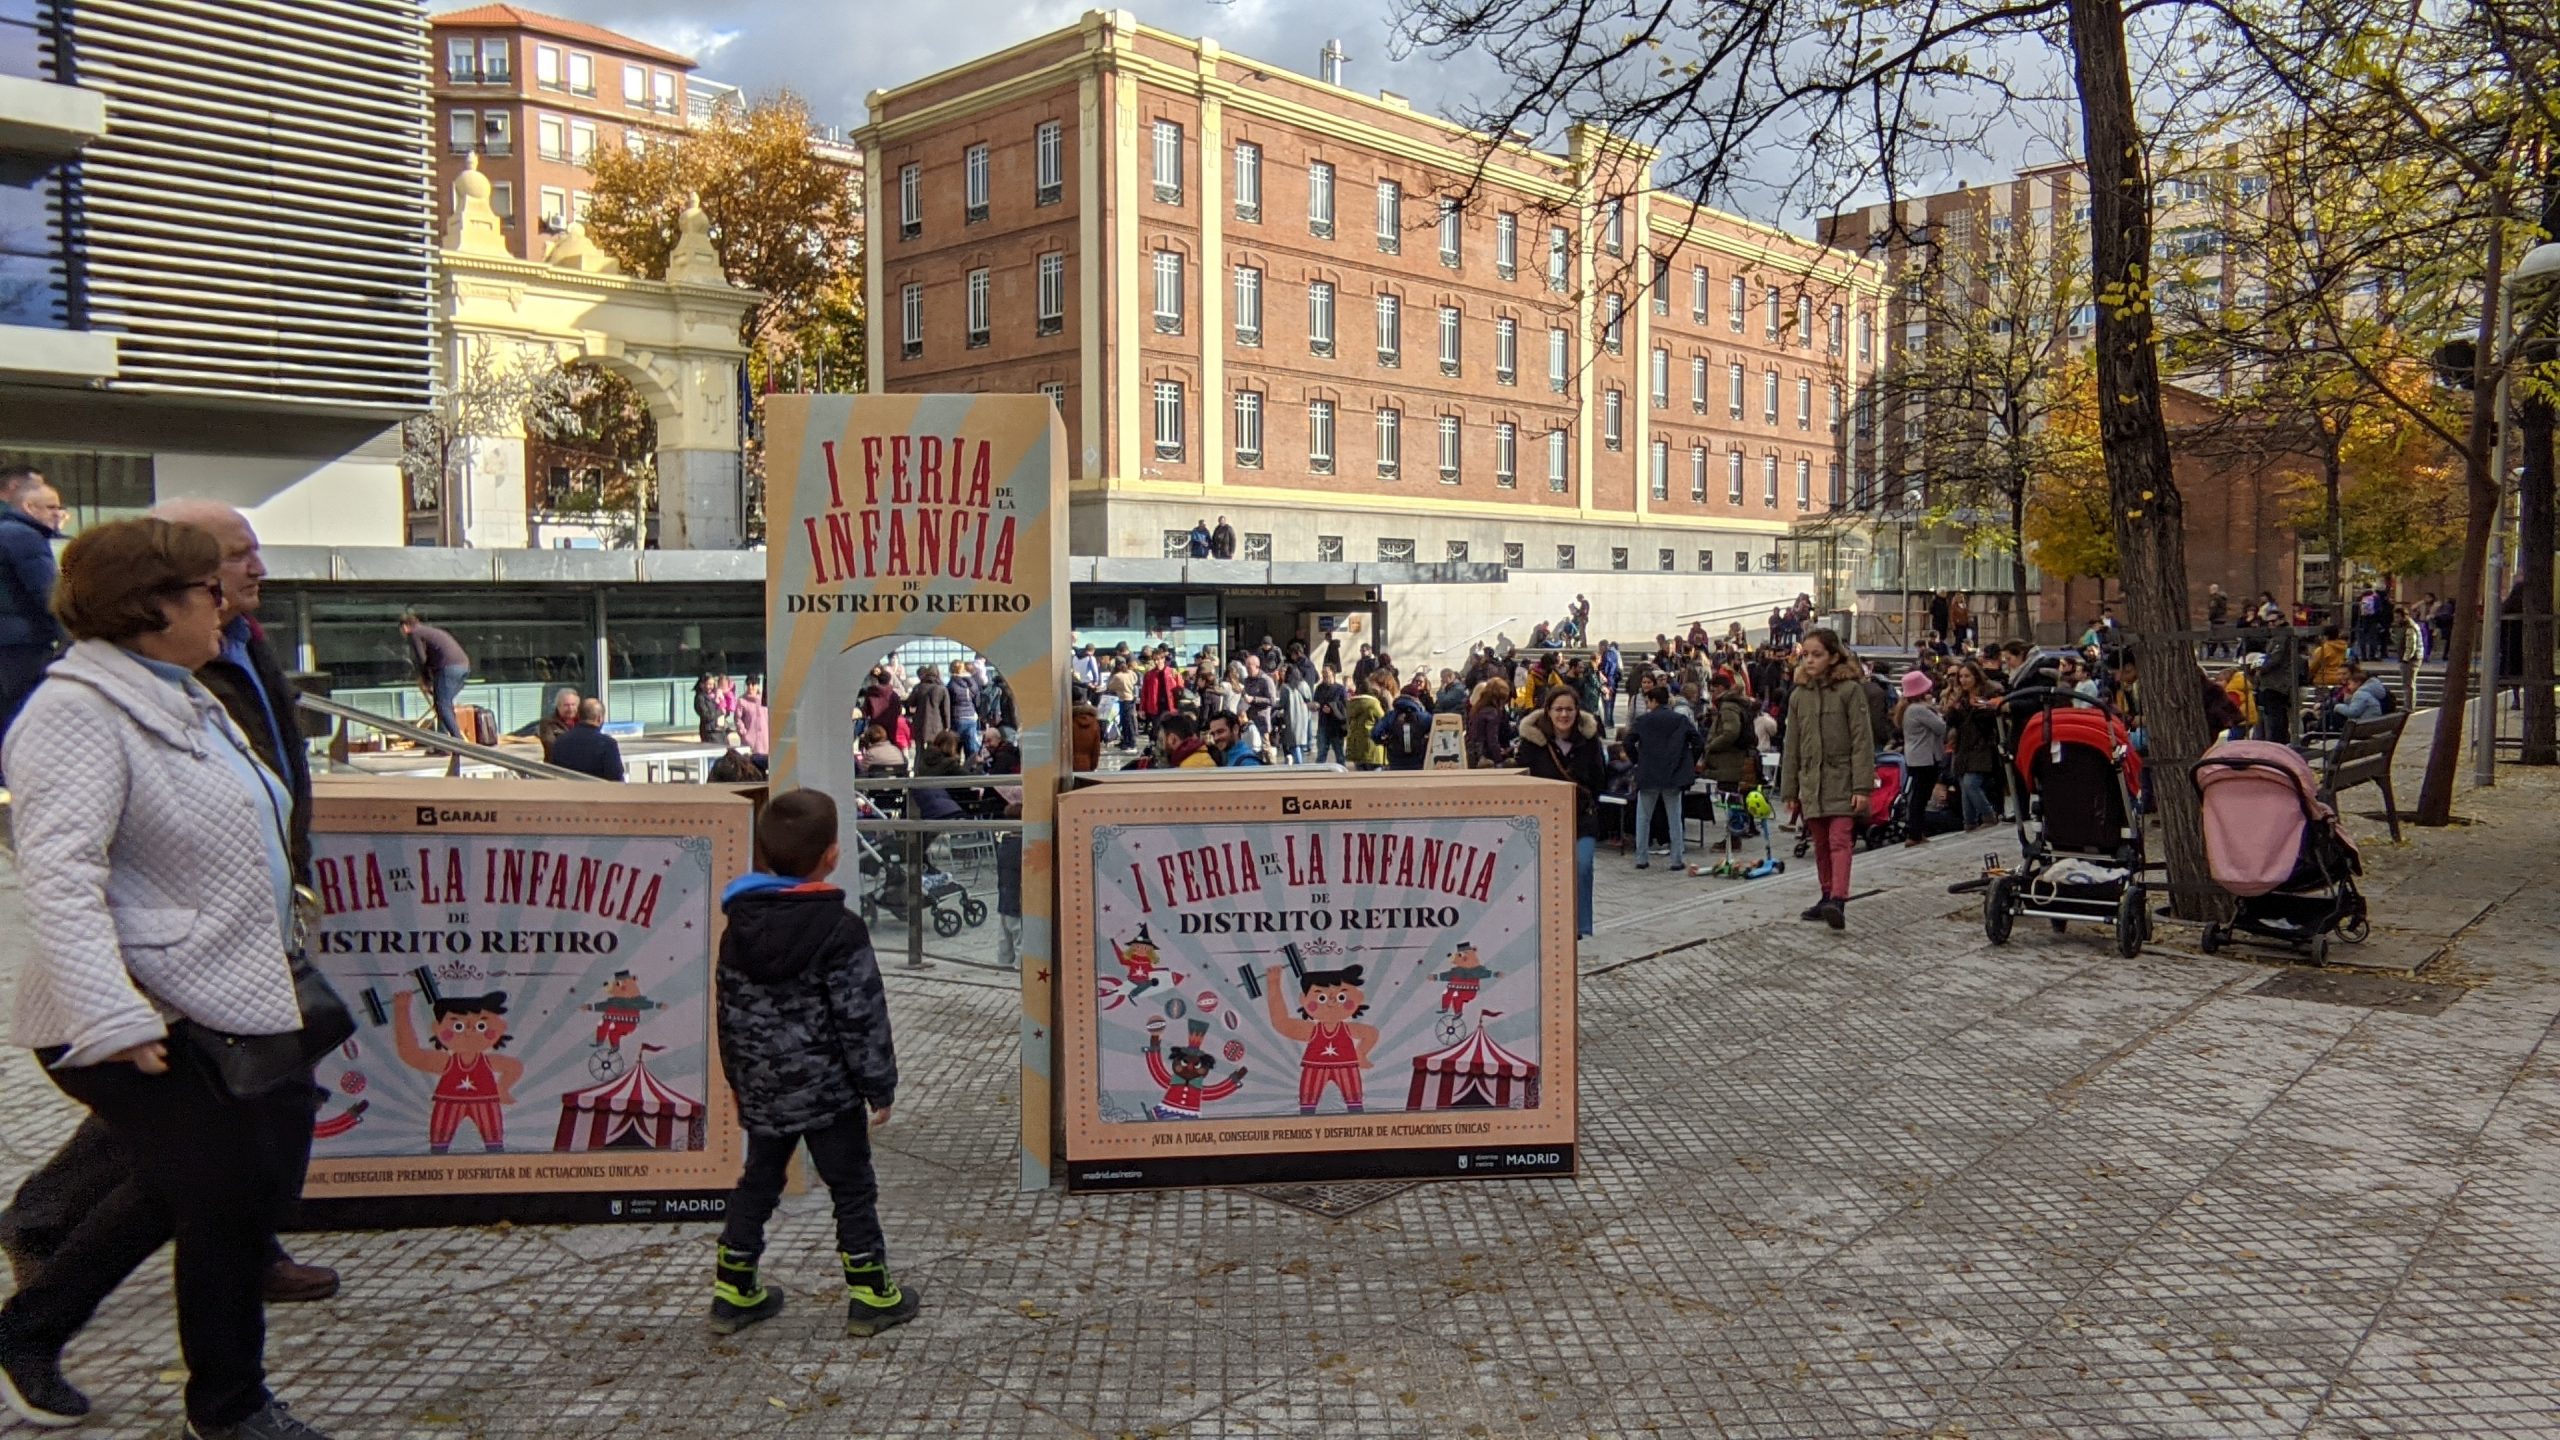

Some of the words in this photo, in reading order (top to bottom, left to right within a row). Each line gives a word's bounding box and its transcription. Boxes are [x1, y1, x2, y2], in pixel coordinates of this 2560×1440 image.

[822, 441, 843, 508] I
[862, 436, 991, 508] FERIA
[995, 487, 1014, 498] DE
[998, 500, 1016, 510] LA
[804, 508, 1016, 584] INFANCIA
[902, 581, 920, 592] DE
[787, 594, 919, 613] DISTRITO
[926, 593, 1031, 613] RETIRO
[1302, 799, 1352, 810] GARAJE
[440, 811, 497, 822] GARAJE
[1260, 853, 1279, 865] DE
[389, 867, 411, 880] DE
[1265, 865, 1283, 876] LA
[1284, 834, 1326, 886] LA
[1342, 833, 1496, 902] INFANCIA
[316, 850, 389, 915] RIA
[1130, 863, 1152, 913] I
[1157, 840, 1261, 907] FERIA
[393, 880, 415, 892] LA
[419, 848, 466, 904] LA
[484, 848, 662, 928] INFANCIA
[1311, 893, 1330, 904] DE
[448, 913, 470, 924] DE
[1179, 910, 1332, 934] DISTRITO
[1339, 906, 1460, 930] RETIRO
[319, 930, 472, 954] ISTRITO
[481, 930, 618, 954] RETIRO
[1176, 1133, 1183, 1144] A
[1185, 1132, 1217, 1146] JUGAR,
[1219, 1130, 1270, 1143] CONSEGUIR
[1272, 1128, 1313, 1140] PREMIOS
[1315, 1128, 1321, 1139] Y
[1324, 1126, 1373, 1139] DISFRUTAR
[1376, 1125, 1388, 1137] DE
[1391, 1123, 1452, 1136] ACTUACIONES
[1506, 1153, 1560, 1165] MADRID
[333, 1171, 394, 1184] CONSEGUIR
[397, 1169, 444, 1181] PREMIOS
[447, 1169, 453, 1180] Y
[457, 1167, 515, 1180] DISFRUTAR
[518, 1167, 532, 1179] DE
[535, 1166, 605, 1179] ACTUACIONES
[666, 1199, 726, 1212] MADRID
